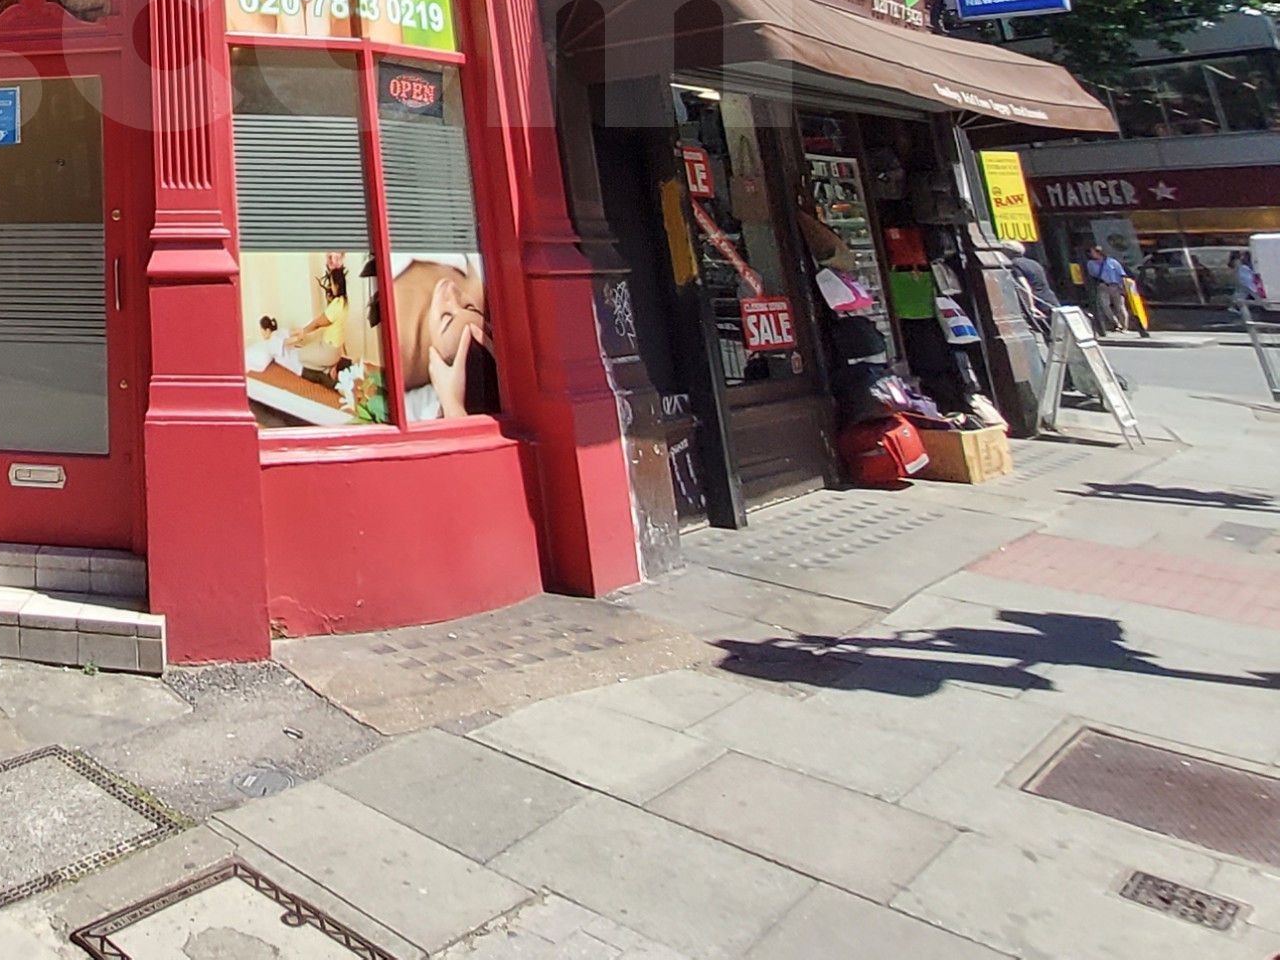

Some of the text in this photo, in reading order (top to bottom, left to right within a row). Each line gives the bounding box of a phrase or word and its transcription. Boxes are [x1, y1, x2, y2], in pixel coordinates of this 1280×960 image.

[389, 79, 437, 103] OPEN
[685, 161, 710, 193] LE
[993, 193, 1025, 208] RAW
[747, 312, 794, 346] SALE
